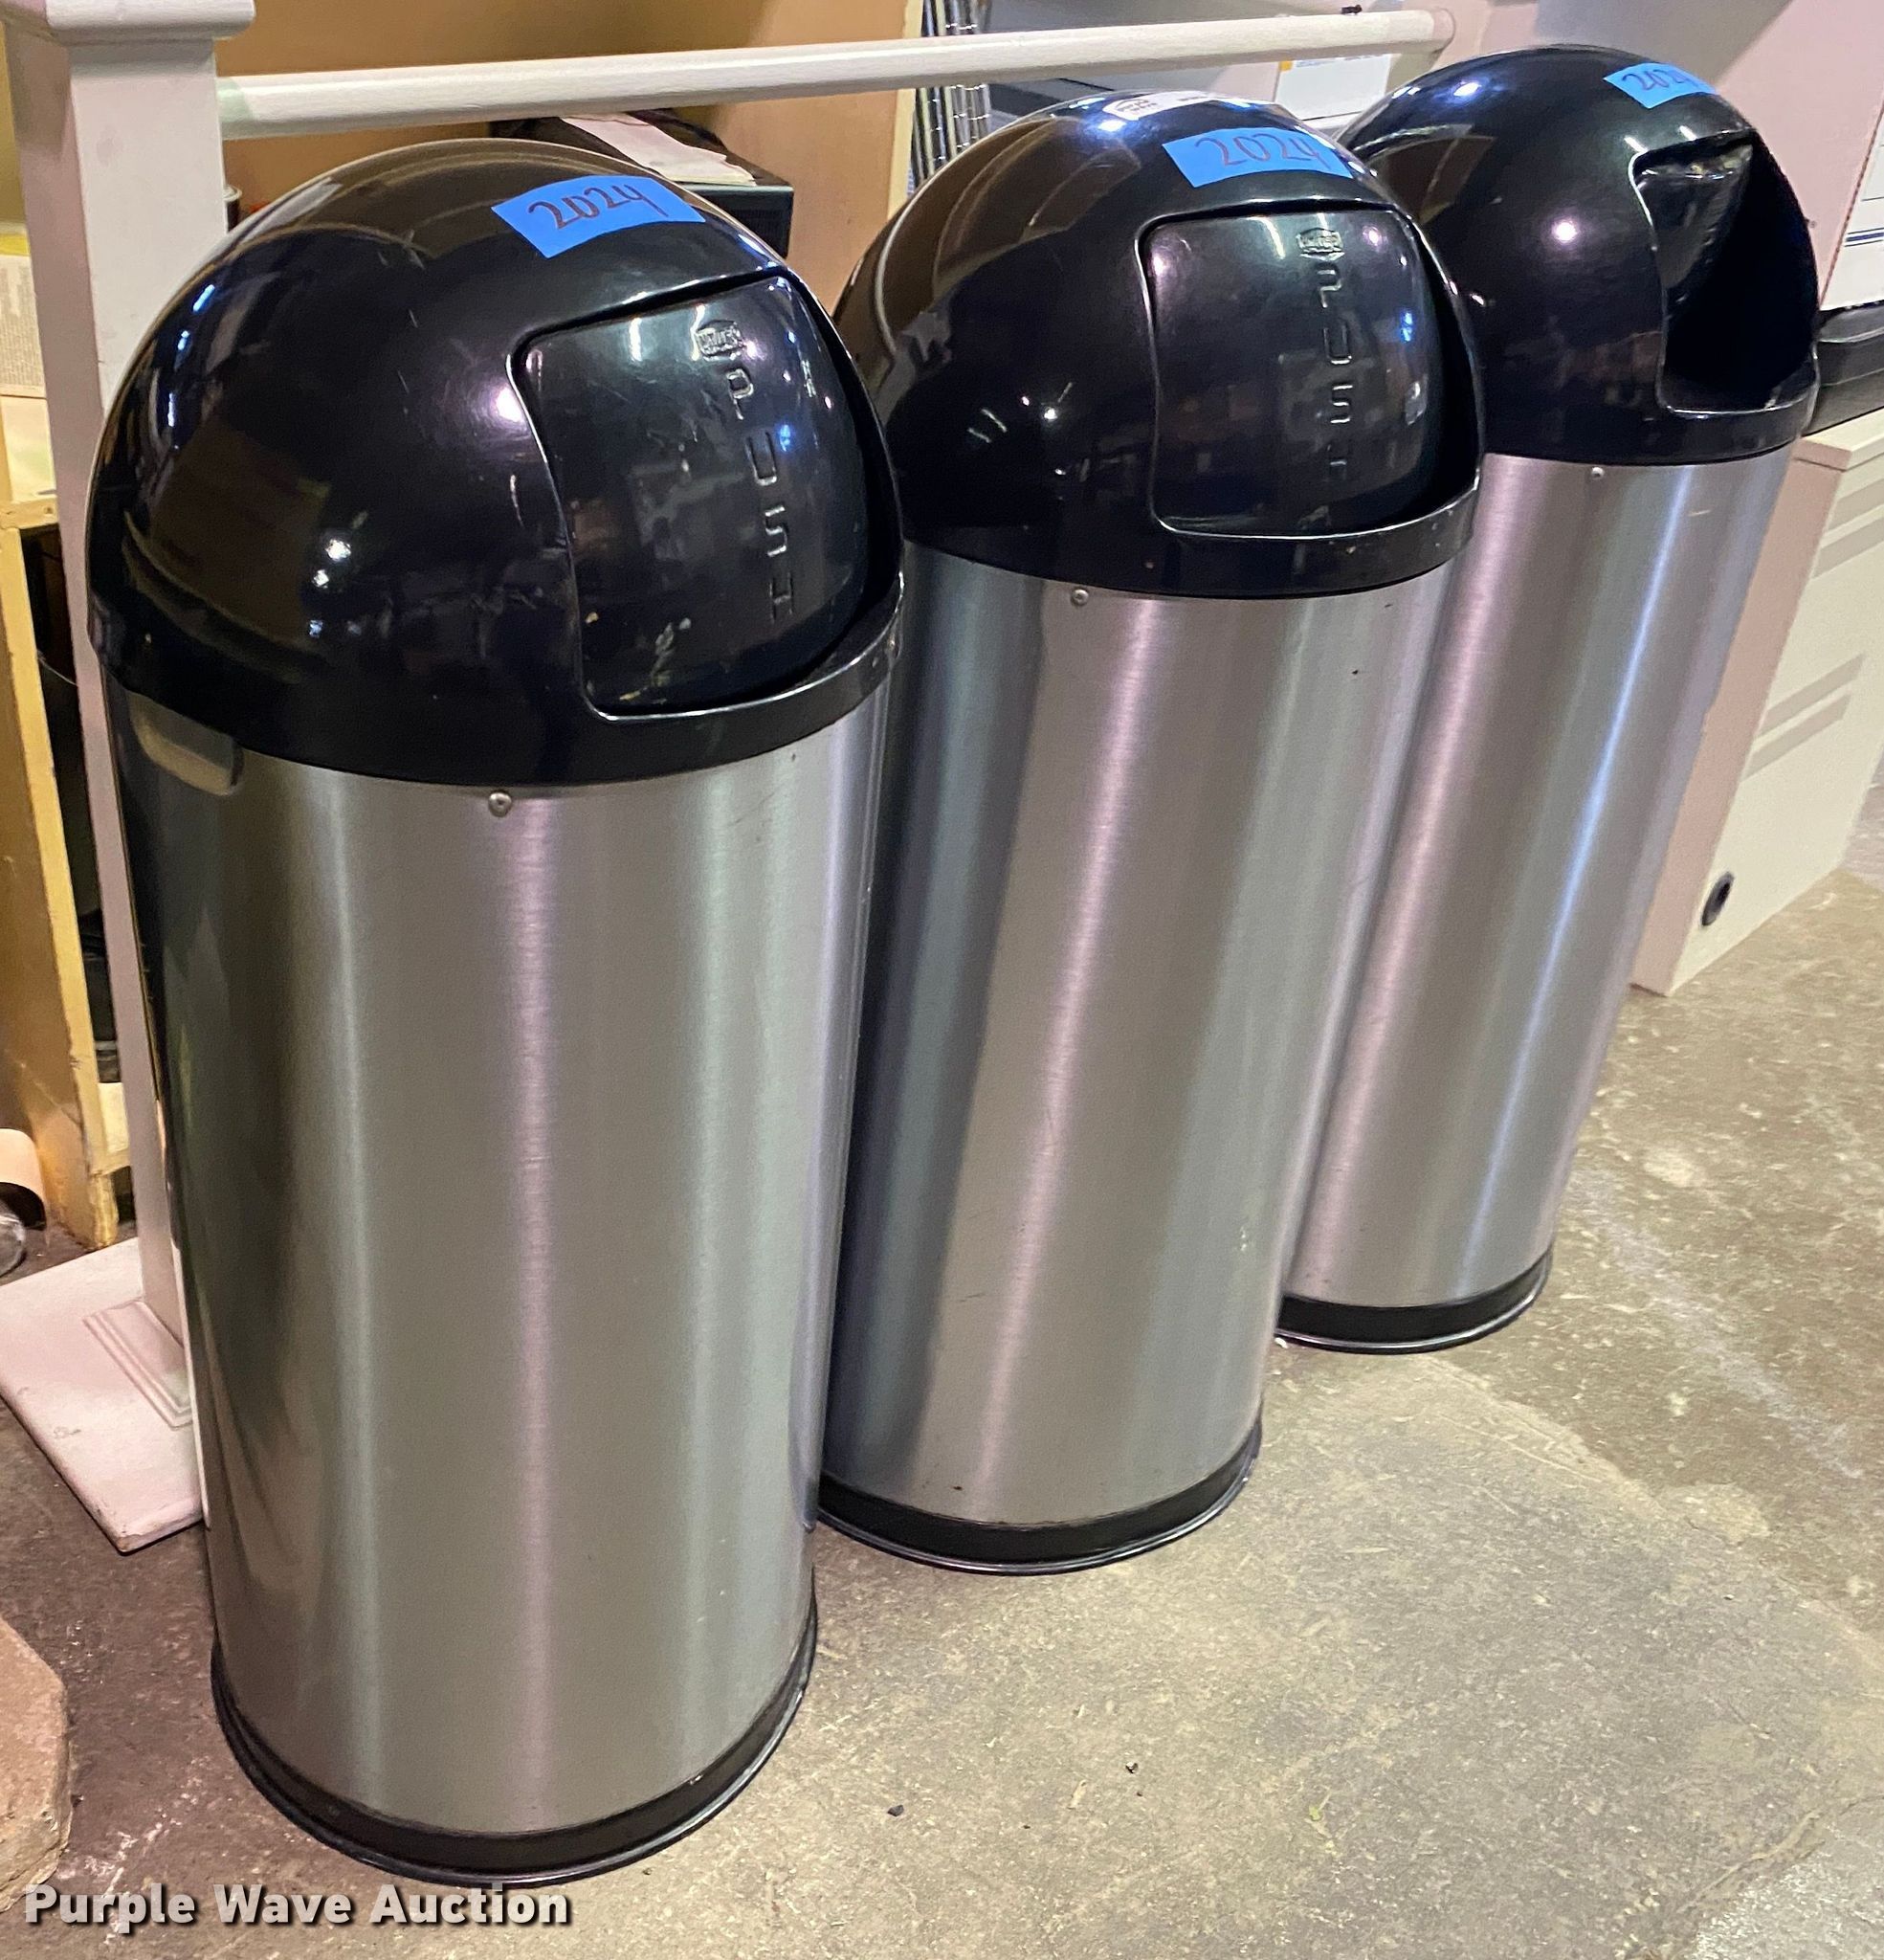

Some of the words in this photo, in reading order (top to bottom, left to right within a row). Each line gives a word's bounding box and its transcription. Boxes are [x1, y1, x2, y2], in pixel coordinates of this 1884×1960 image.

[1195, 132, 1332, 167] 2024
[528, 184, 669, 230] 2024
[725, 368, 794, 622] PUSH
